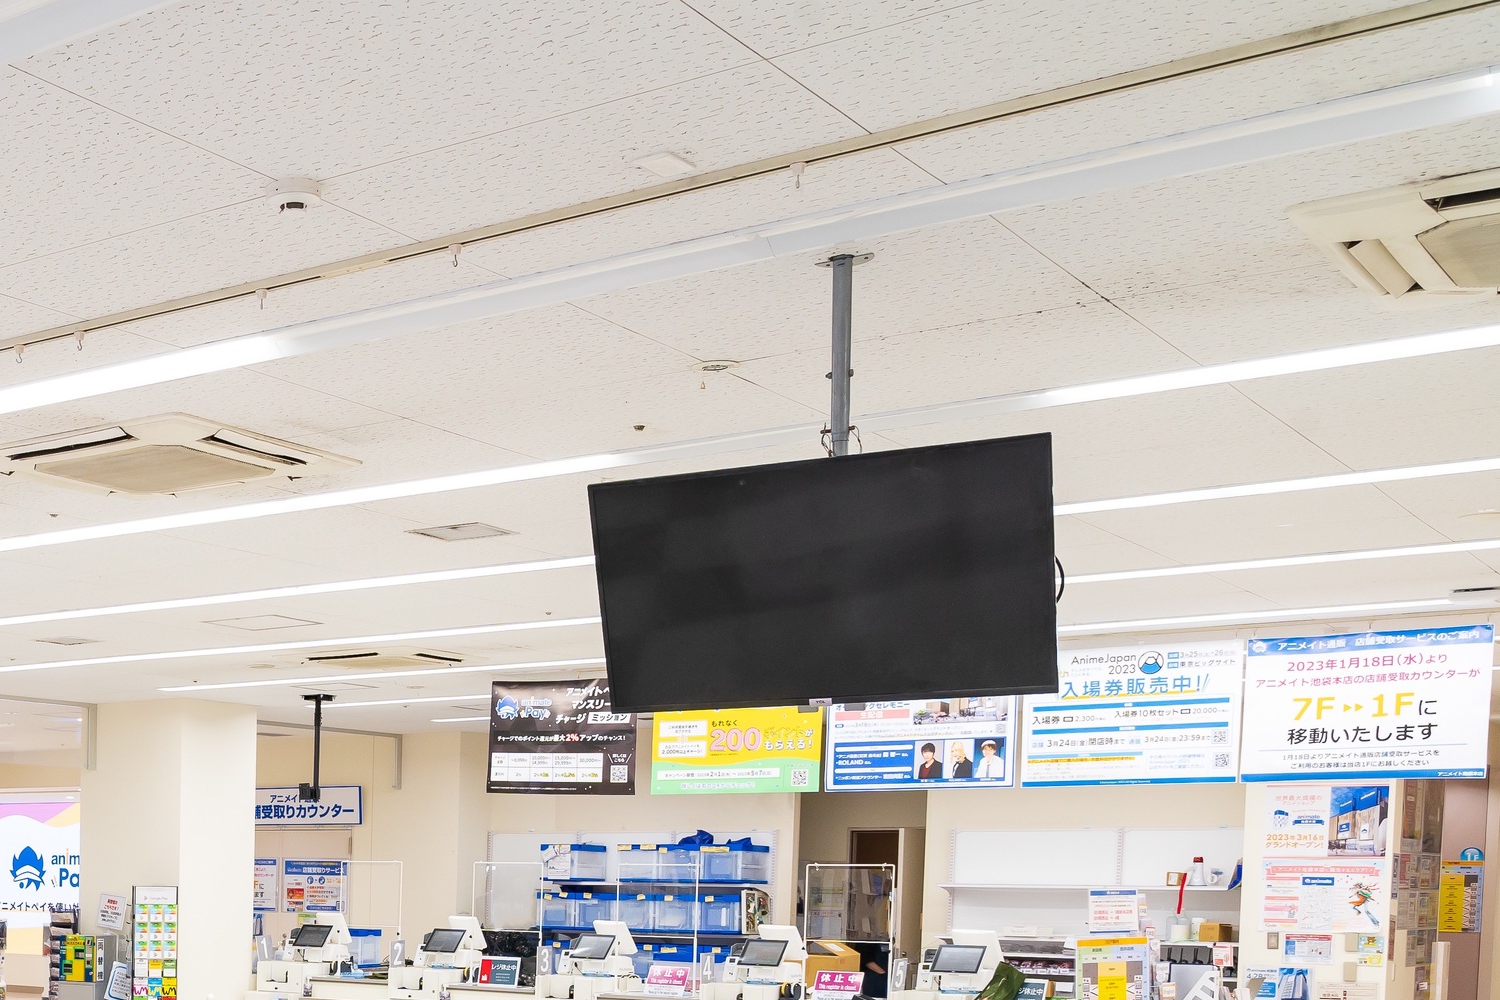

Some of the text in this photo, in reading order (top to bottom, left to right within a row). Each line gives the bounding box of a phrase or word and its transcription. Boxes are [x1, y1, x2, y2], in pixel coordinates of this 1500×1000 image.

[1070, 653, 1137, 666] AnimeJapan
[1108, 665, 1137, 676] 2023
[1255, 668, 1481, 688] アニメイト池袋本店の店舗受取カウンターが
[555, 713, 628, 724] チャージ ミッション
[1292, 696, 1336, 720] 7F
[711, 720, 738, 728] もれなく
[1032, 715, 1060, 726] 入場券
[710, 727, 762, 752] 200
[1287, 722, 1439, 745] 移動いたします
[1265, 841, 1324, 849] グランドオープン!
[261, 937, 269, 959] 1
[393, 942, 402, 965] 2
[540, 948, 549, 972] 3
[703, 955, 712, 980] 4
[821, 973, 857, 983] 休止中
[895, 961, 904, 988] 5
